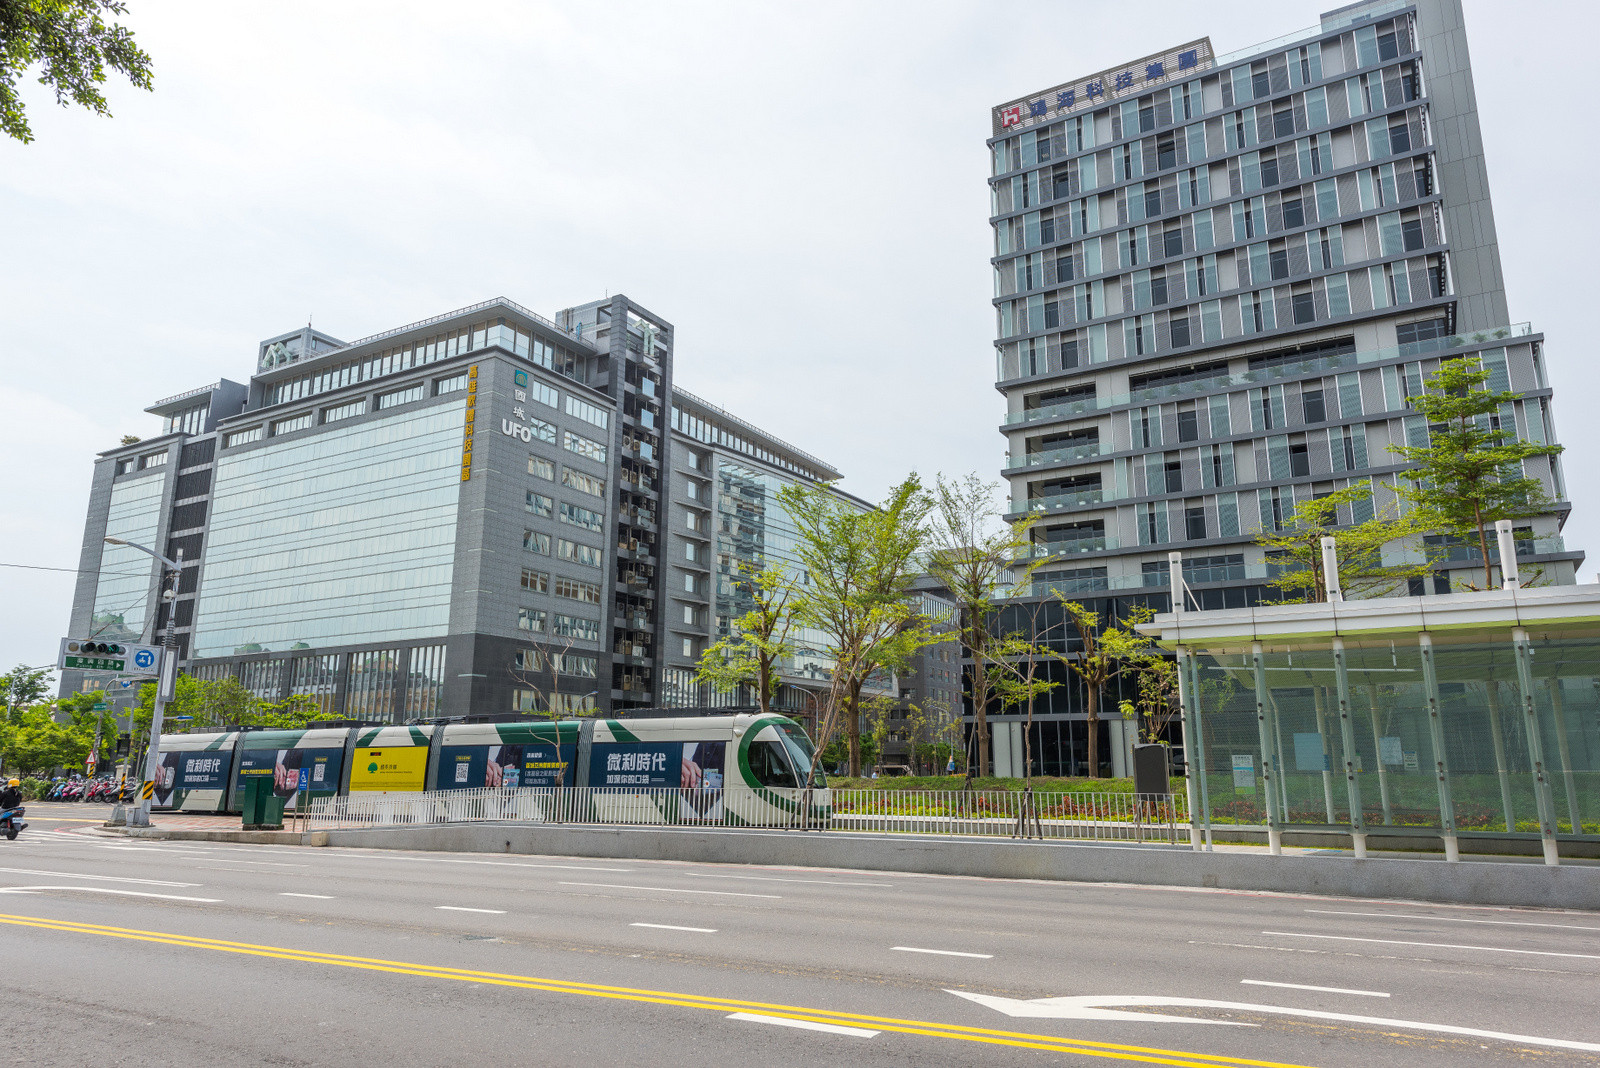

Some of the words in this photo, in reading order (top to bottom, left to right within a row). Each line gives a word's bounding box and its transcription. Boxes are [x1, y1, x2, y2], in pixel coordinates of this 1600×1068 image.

[1030, 49, 1198, 118] 鴻海科技集團
[502, 418, 531, 443] UFO
[185, 758, 221, 773] 微利時代
[607, 752, 667, 772] 微利時代
